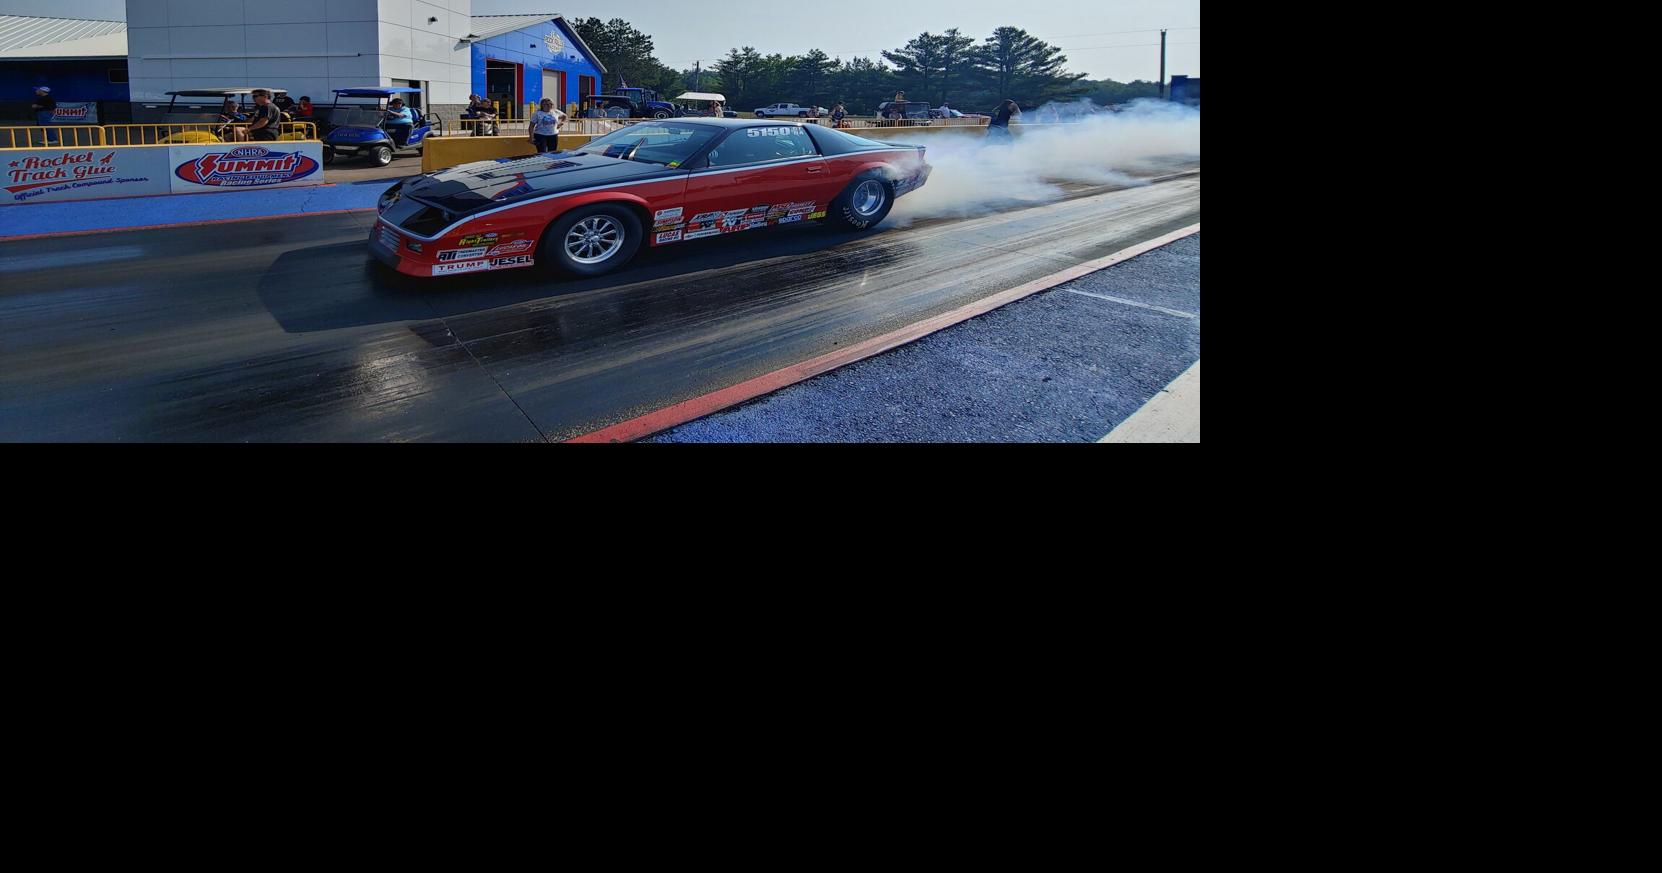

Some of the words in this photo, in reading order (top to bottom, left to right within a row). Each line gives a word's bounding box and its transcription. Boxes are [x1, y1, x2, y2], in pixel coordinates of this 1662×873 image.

[747, 127, 790, 137] 5150
[235, 149, 263, 157] NHRA
[22, 152, 94, 169] Rocket
[8, 167, 66, 182] Track
[73, 165, 116, 178] Glue
[220, 178, 252, 186] Racing
[253, 177, 282, 185] Series
[14, 189, 44, 201] Official
[46, 185, 71, 193] Track
[73, 179, 113, 188] Compound
[115, 176, 149, 184] Sponsor
[439, 250, 458, 261] ATI
[439, 262, 484, 270] TRUMP
[490, 256, 532, 266] JESEL
